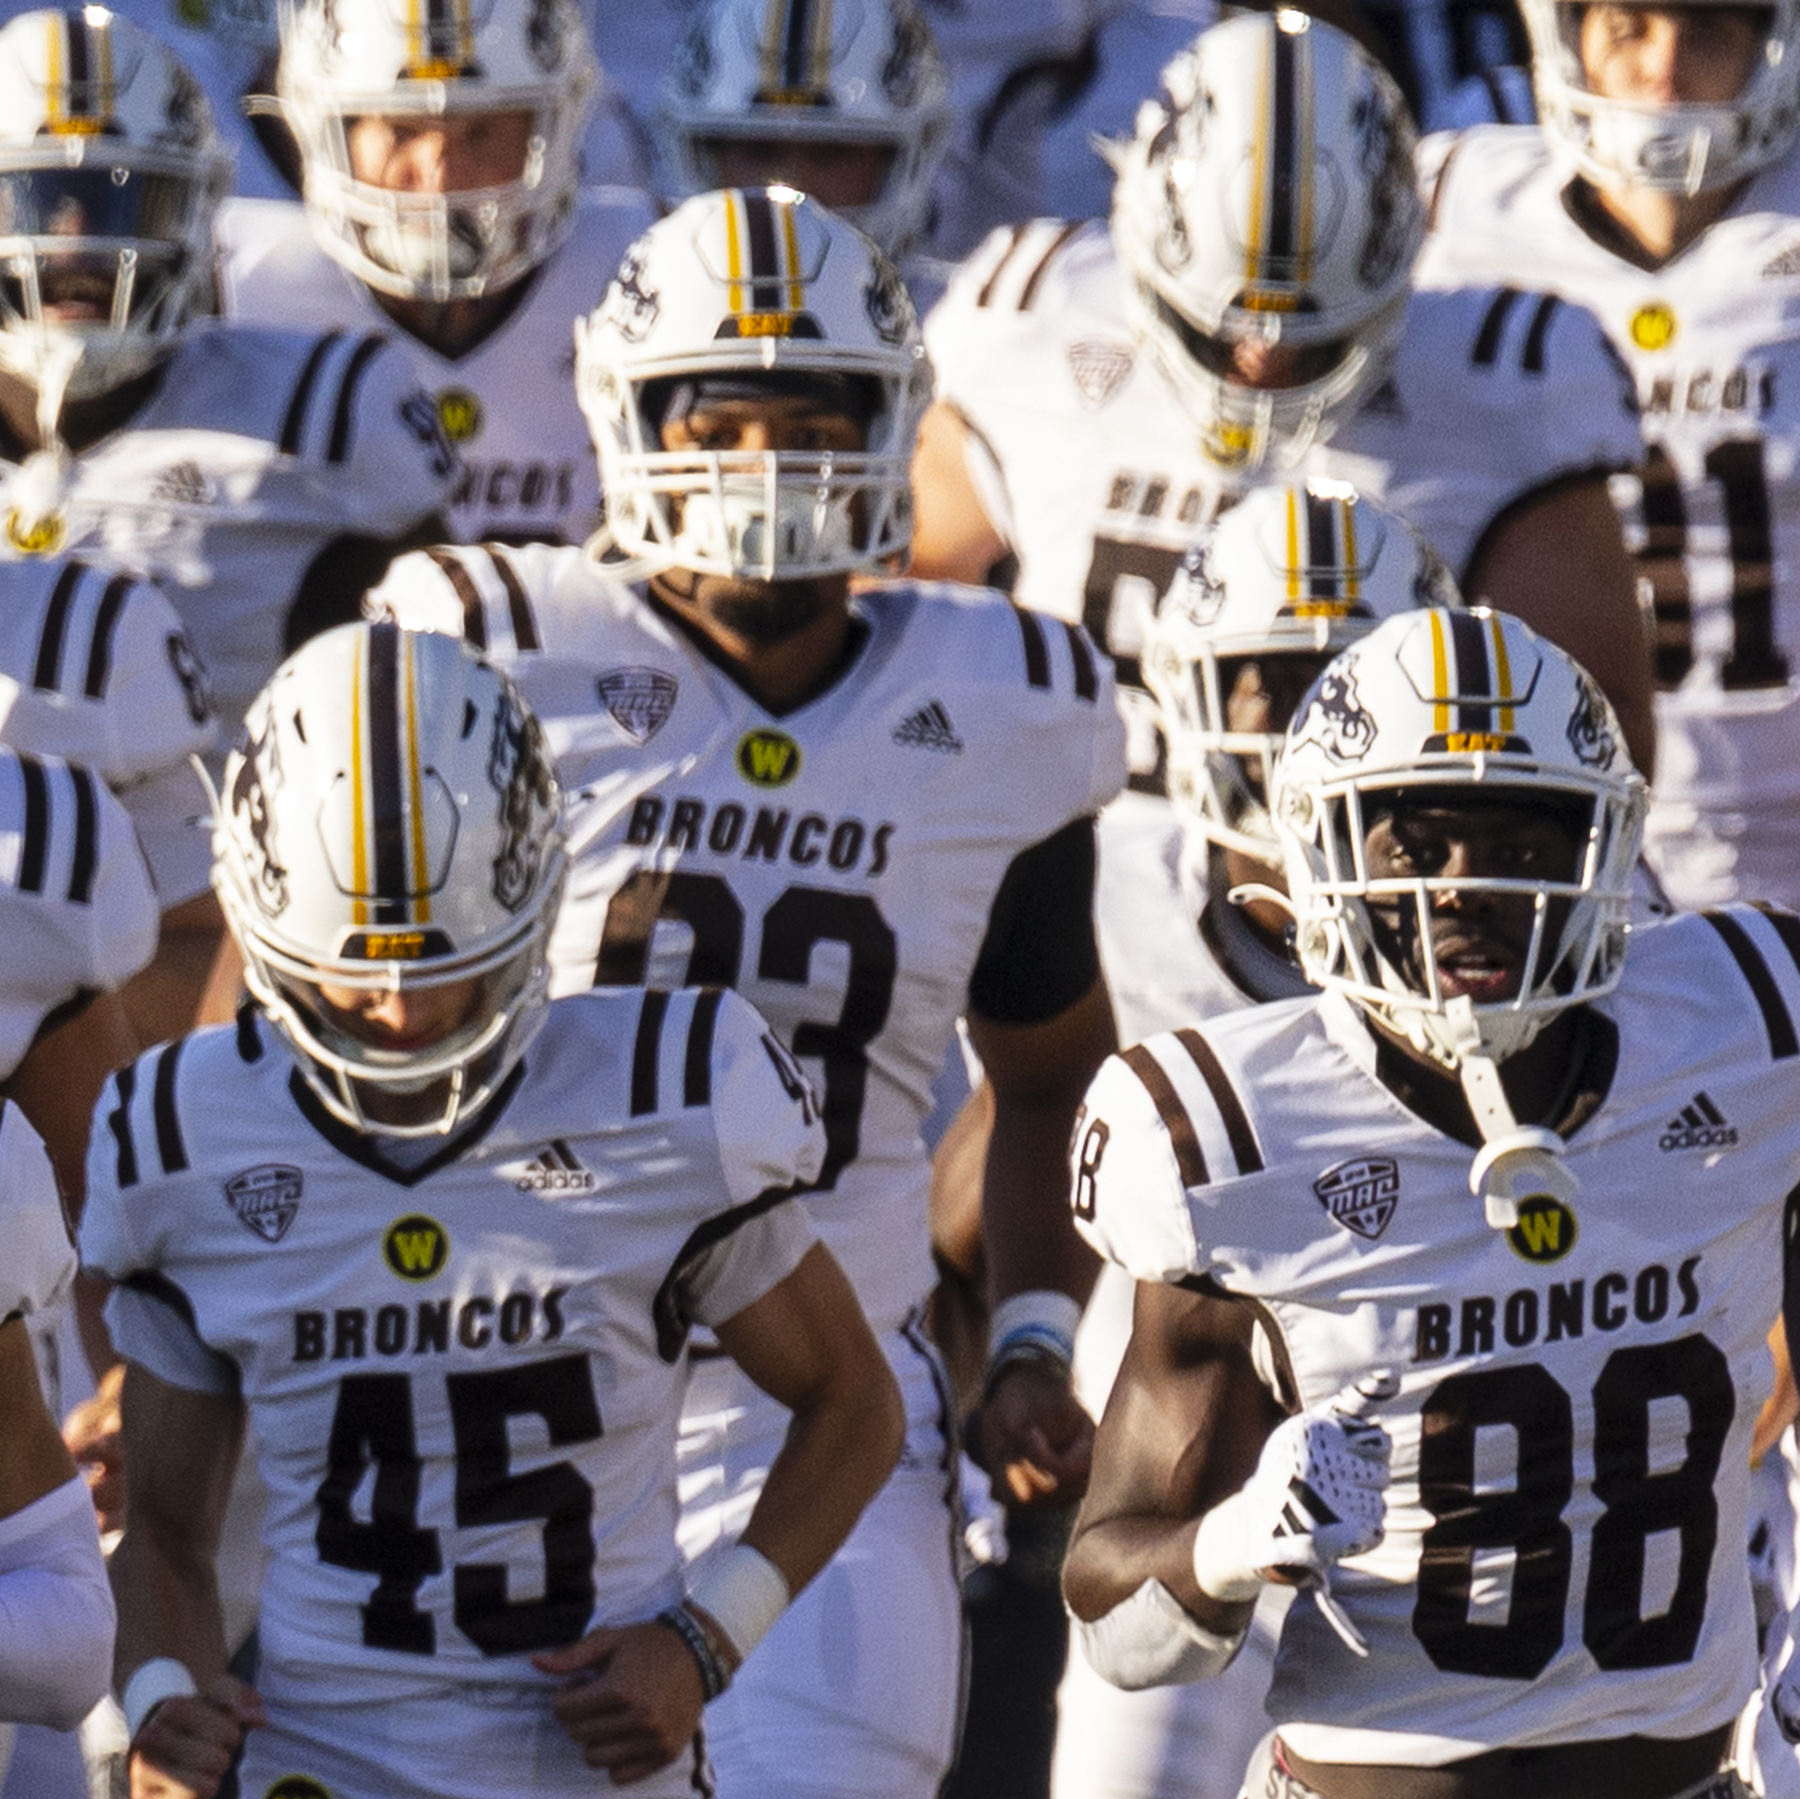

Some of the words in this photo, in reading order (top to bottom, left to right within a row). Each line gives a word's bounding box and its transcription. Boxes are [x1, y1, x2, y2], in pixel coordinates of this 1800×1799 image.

[749, 740, 790, 778] W
[625, 797, 898, 879] BRONCOS
[1659, 1128, 1740, 1152] adidas
[516, 1170, 596, 1192] adidas
[1330, 1178, 1398, 1212] MAC
[393, 1231, 437, 1270] W
[1519, 1208, 1560, 1254] W
[293, 1289, 568, 1362] BRONCOS
[1411, 1257, 1704, 1363] BRONCOS
[314, 1356, 605, 1657] 45
[1412, 1332, 1737, 1681] 88
